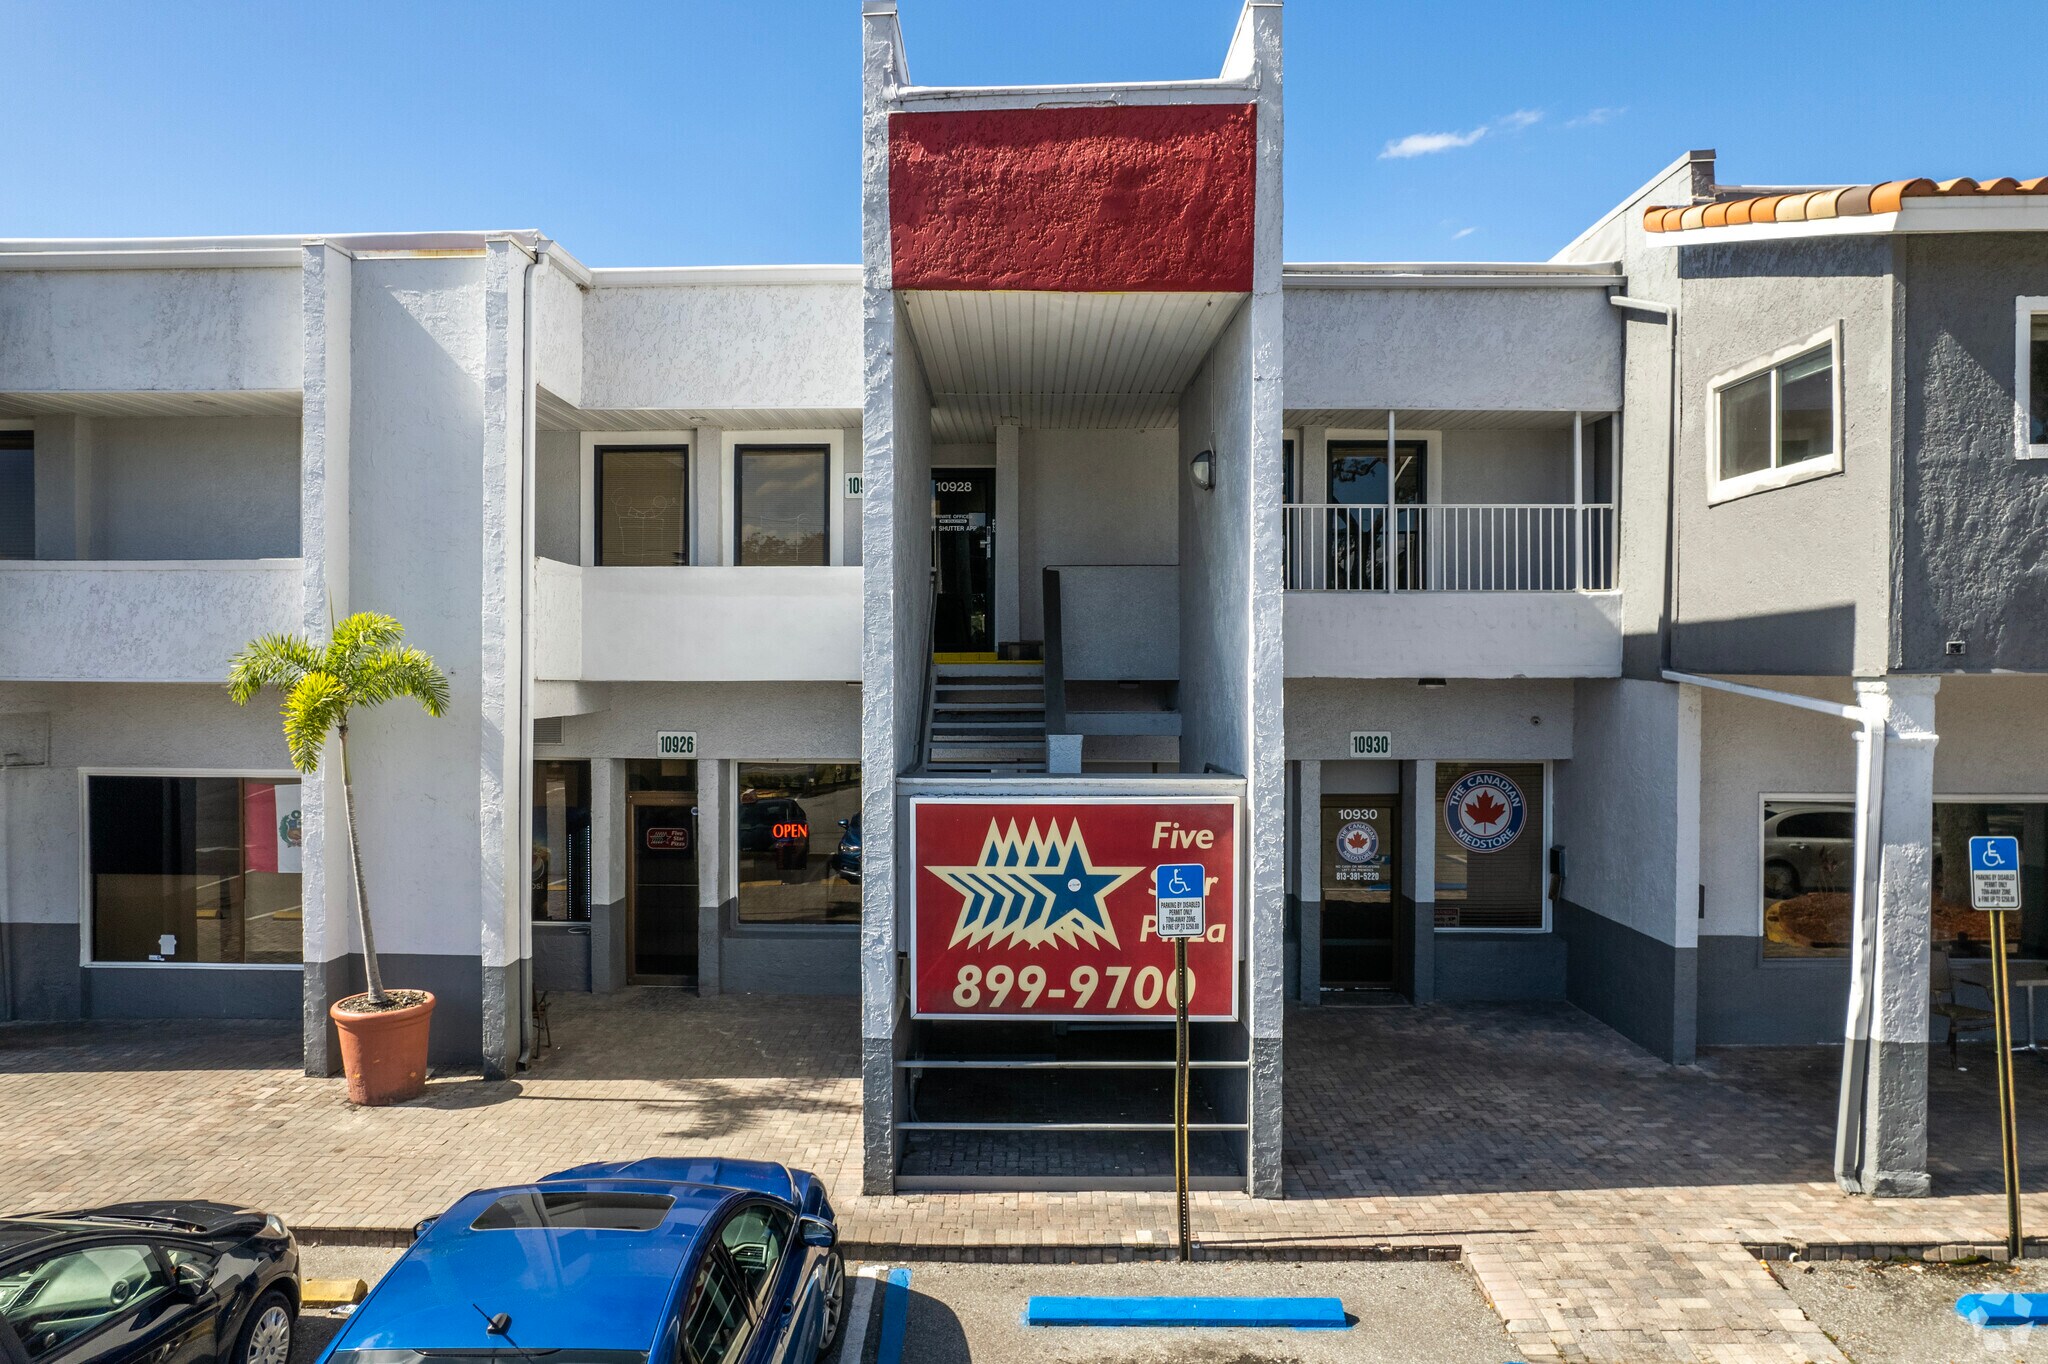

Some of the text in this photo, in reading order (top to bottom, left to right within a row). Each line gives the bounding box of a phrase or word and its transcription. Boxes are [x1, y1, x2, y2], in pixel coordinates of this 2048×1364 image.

[936, 481, 972, 492] 10928
[660, 736, 694, 753] 10926
[1354, 736, 1388, 753] 10930
[1450, 775, 1521, 806] THE CANADIAN
[1338, 809, 1378, 820] 10930
[772, 823, 809, 838] OPEN
[1152, 822, 1214, 849] Five
[1340, 824, 1376, 840] THE CANADIAN
[1456, 828, 1515, 848] MEDSTORE
[1336, 872, 1379, 881] 813-381-5220
[952, 964, 1196, 1009] 899-9700
